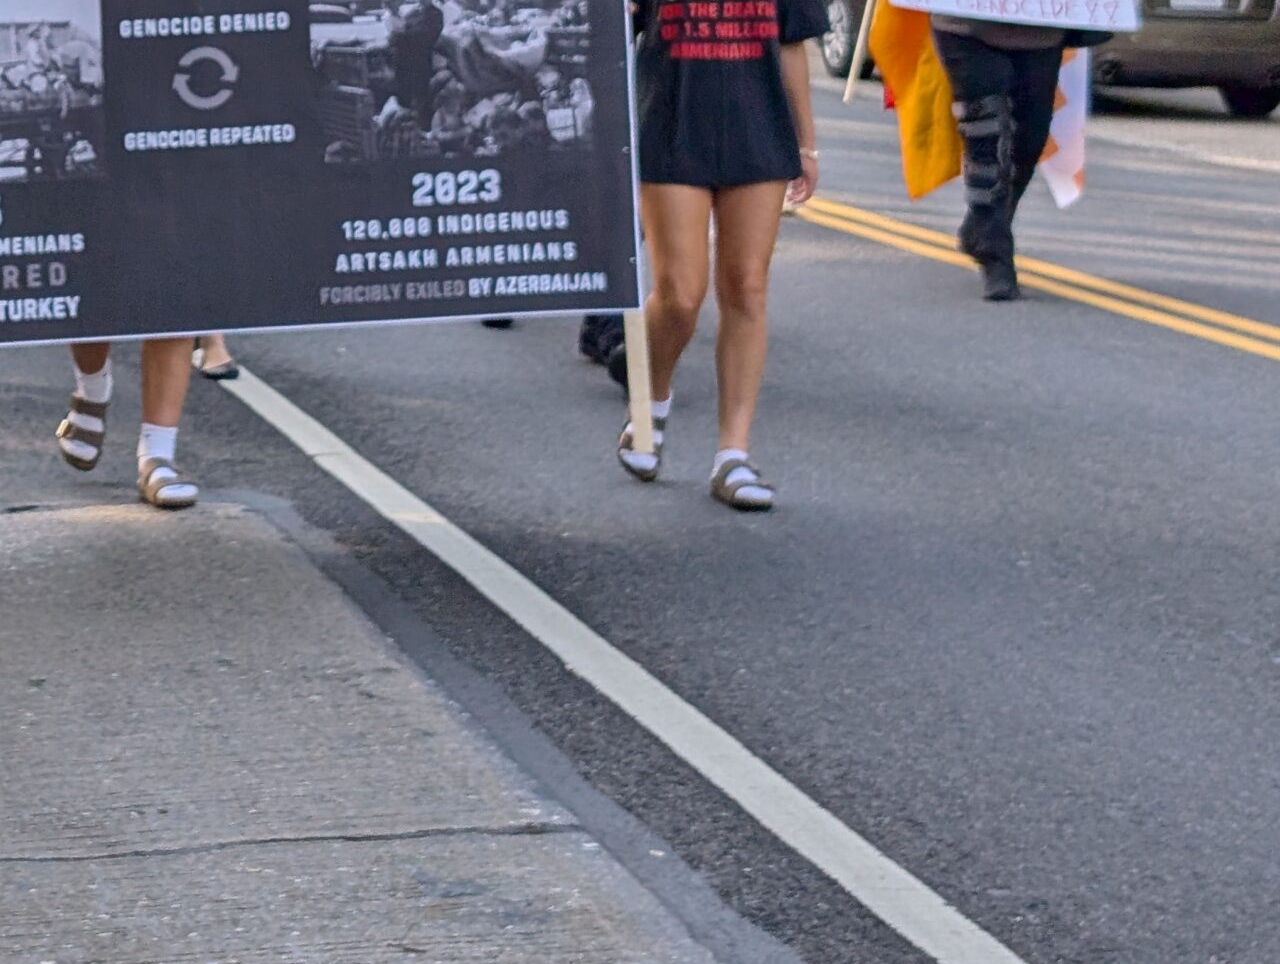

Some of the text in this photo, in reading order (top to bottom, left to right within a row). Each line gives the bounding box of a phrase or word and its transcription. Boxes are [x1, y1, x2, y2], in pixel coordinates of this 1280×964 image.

[688, 1, 719, 18] THE
[723, 0, 777, 18] DEATH
[119, 11, 291, 38] GENOCIDE DENIED
[123, 123, 296, 151] GENOCIDE REPEATED
[411, 168, 502, 207] 2023
[437, 209, 569, 236] INDIGENOUS
[335, 241, 578, 274] ARTSAKH ARMENIANS
[319, 271, 608, 307] FORCIBLY EXILED BY AZERBAIJAN
